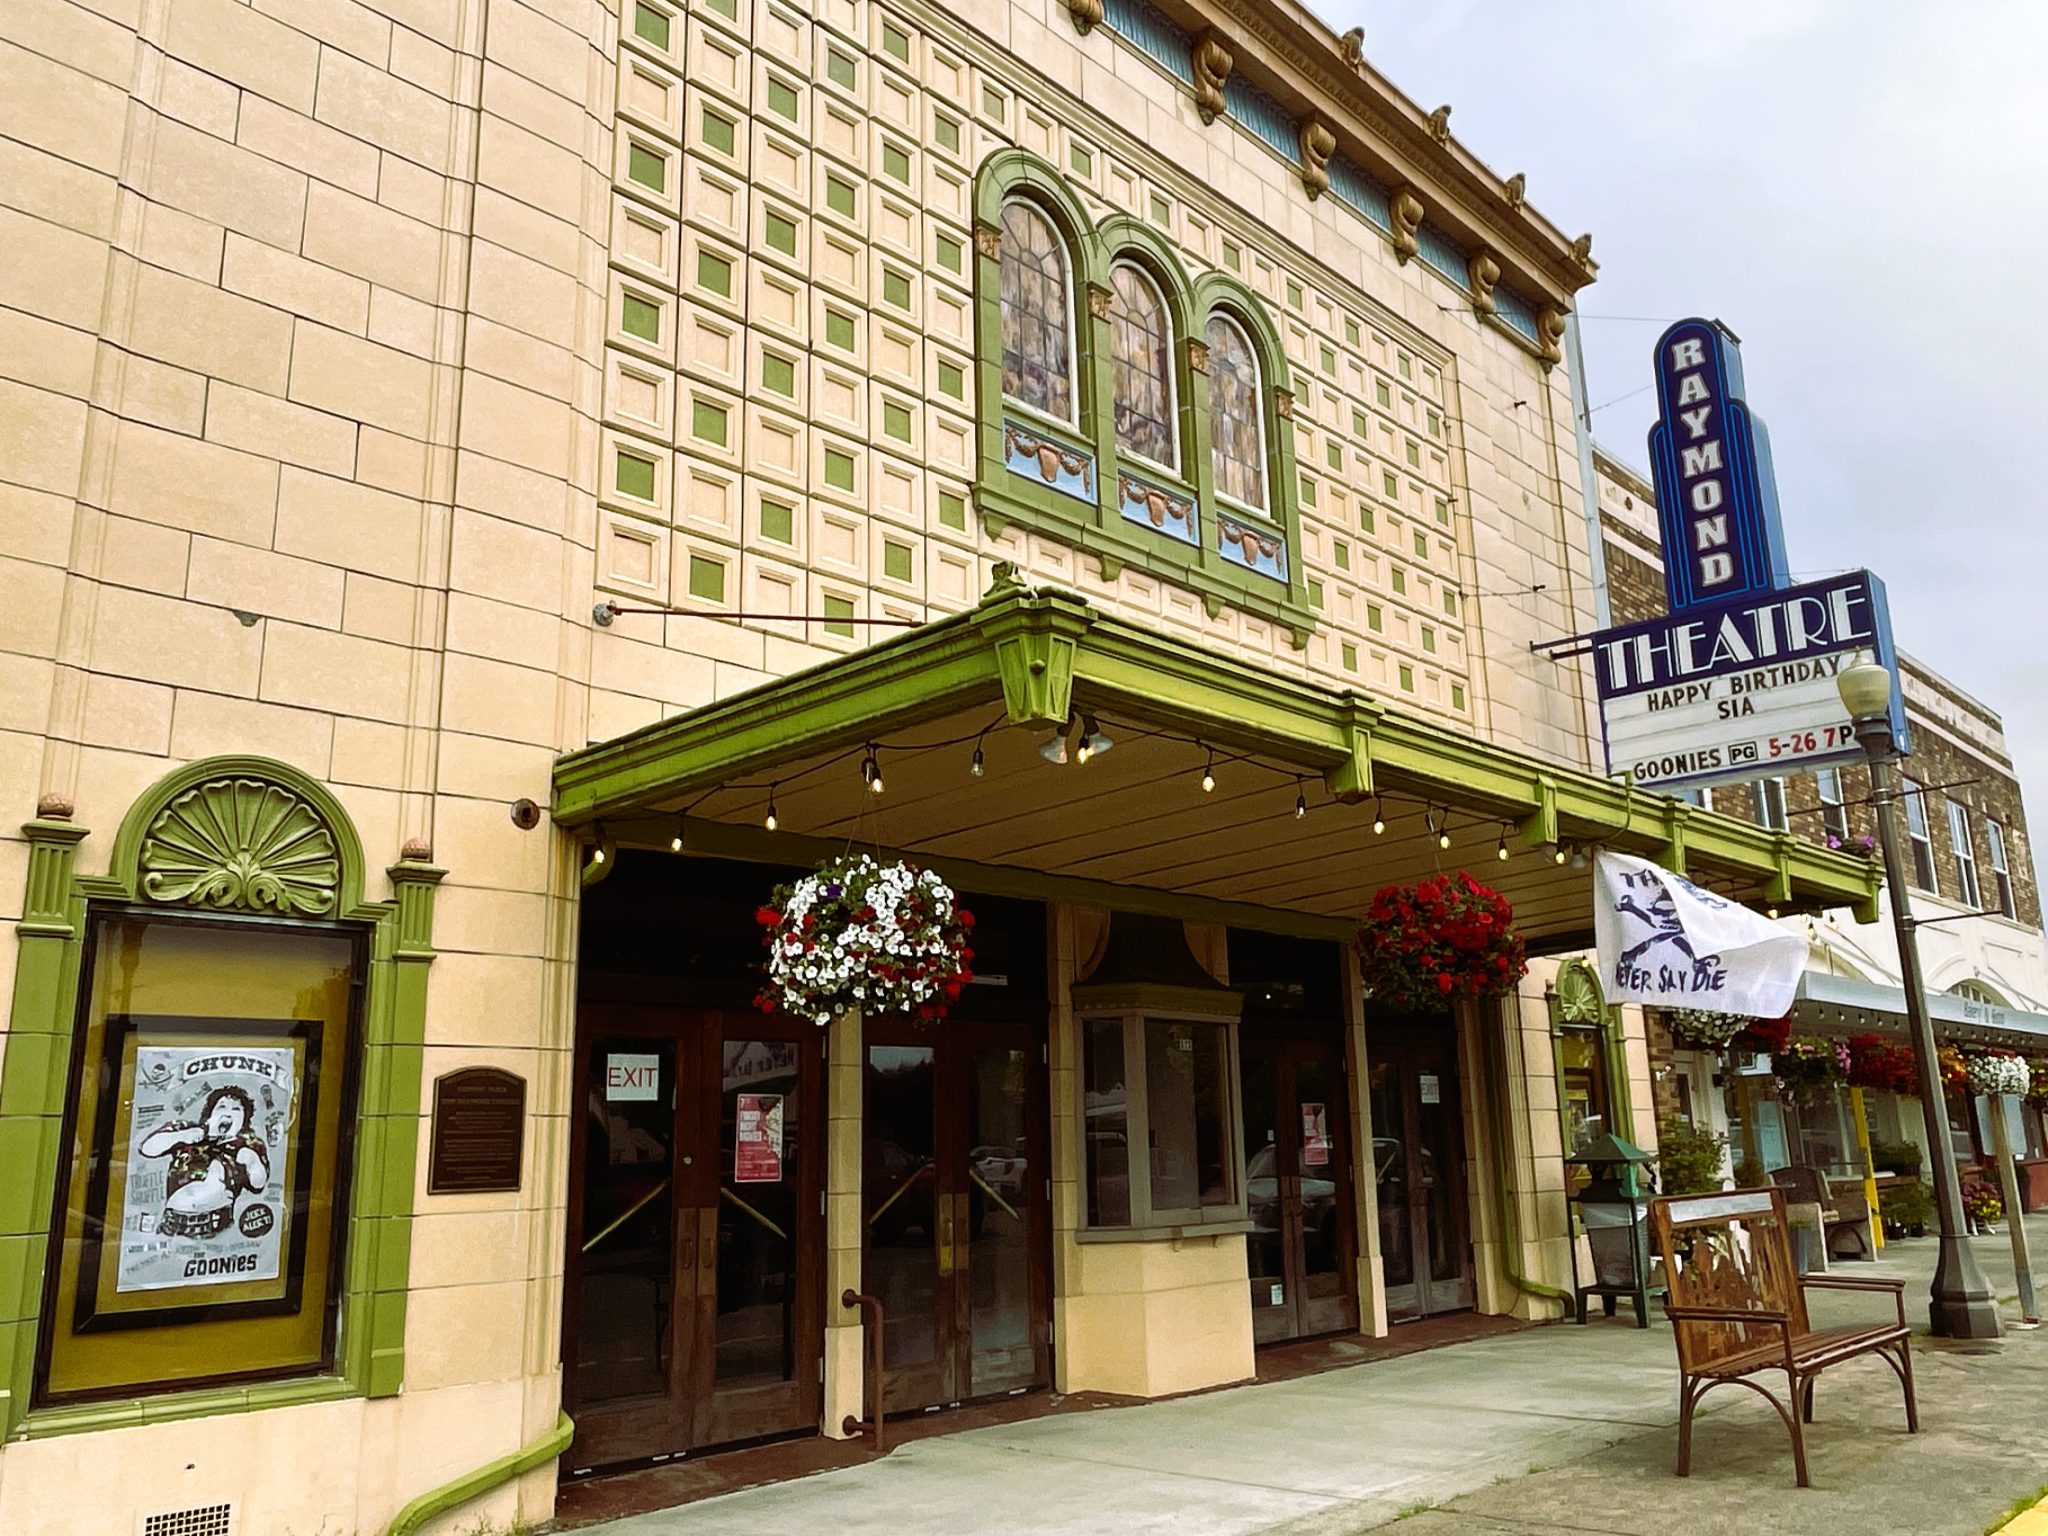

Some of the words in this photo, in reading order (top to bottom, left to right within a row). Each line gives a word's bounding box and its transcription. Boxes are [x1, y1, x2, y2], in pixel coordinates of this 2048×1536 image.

[1671, 337, 1733, 587] RAYMOND
[1598, 584, 1873, 691] THEATRE
[1647, 681, 1712, 712] HAPPY
[1729, 655, 1841, 696] BIRTHDAY
[1717, 699, 1755, 720] SIA
[1633, 748, 1722, 780] GOONIES
[1731, 745, 1756, 761] PG
[1768, 732, 1817, 758] 5-26
[1823, 725, 1856, 749] 7P
[1658, 964, 1687, 993] SAY
[1691, 964, 1728, 993] DIE
[186, 1056, 272, 1077] CHUNK
[607, 1067, 658, 1088] EXIT
